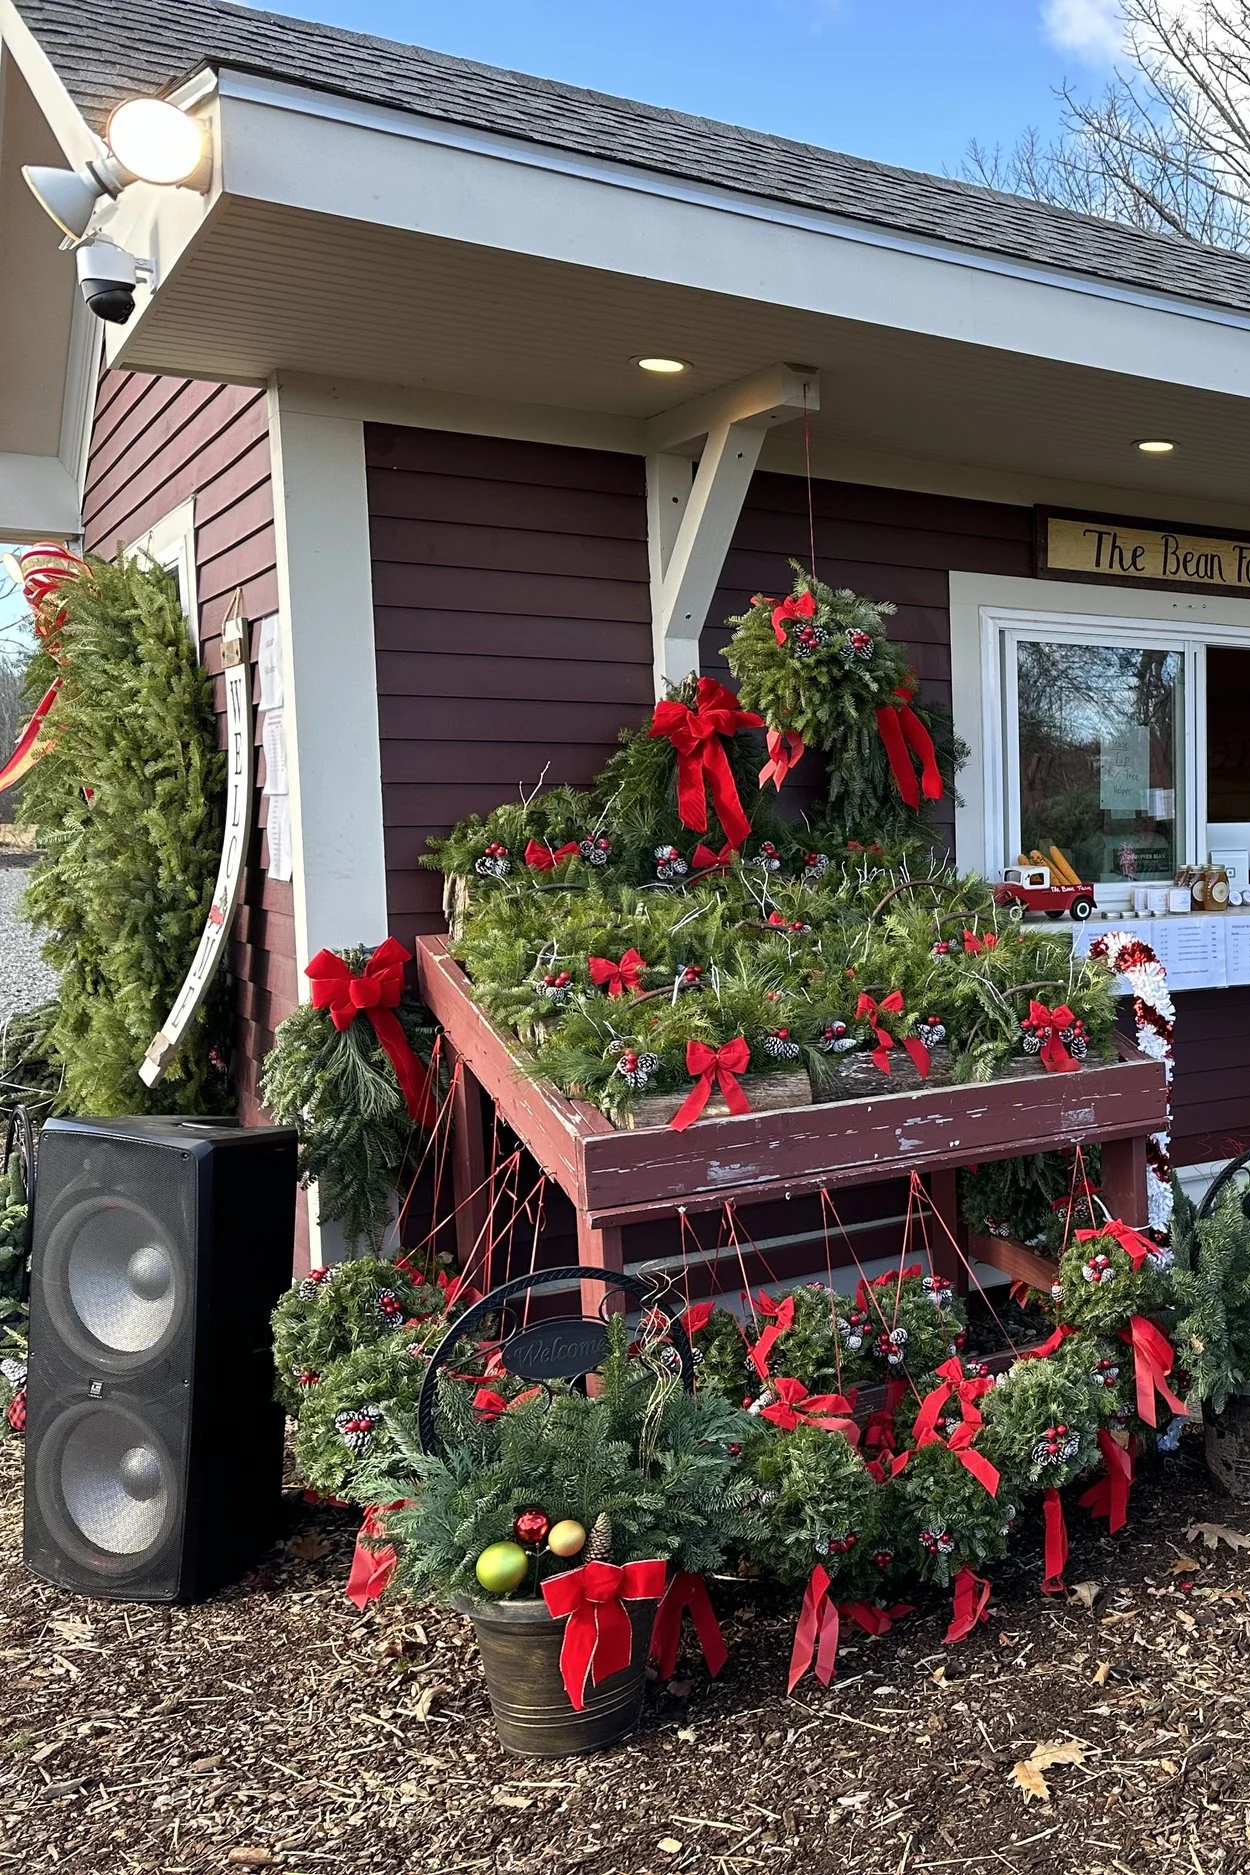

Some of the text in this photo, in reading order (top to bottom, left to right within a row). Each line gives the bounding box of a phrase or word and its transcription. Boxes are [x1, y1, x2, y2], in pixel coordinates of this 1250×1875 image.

[1083, 528, 1145, 572] The
[1161, 534, 1226, 582] Bean
[513, 1335, 607, 1367] Welcome
